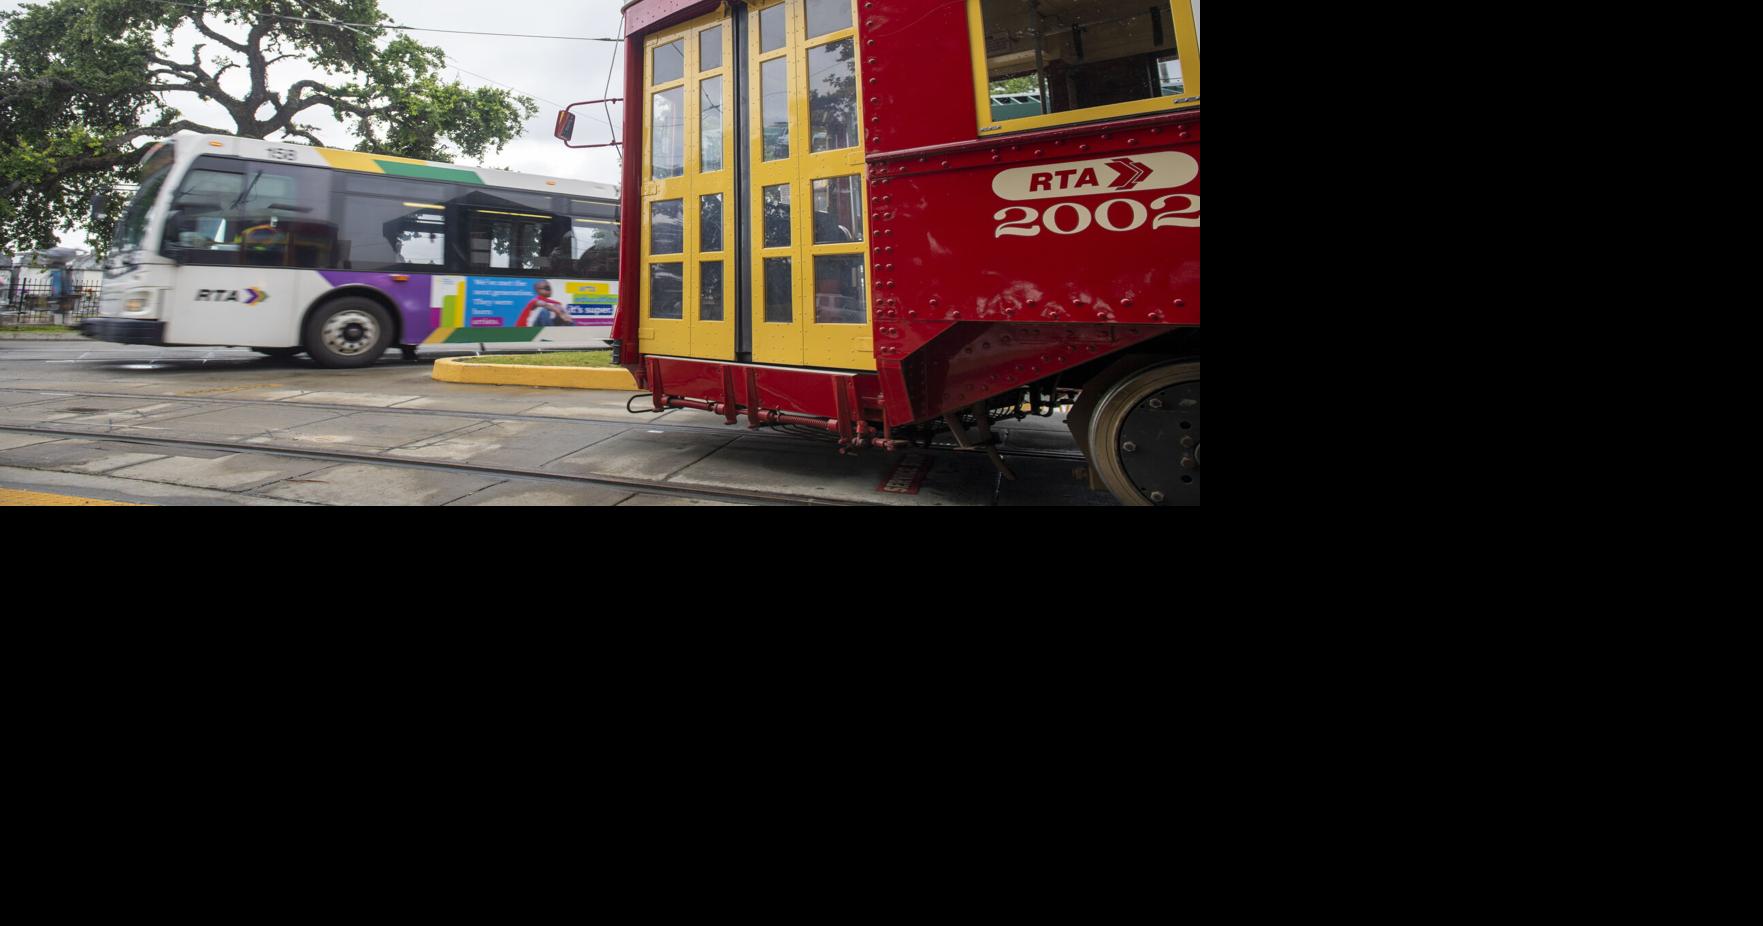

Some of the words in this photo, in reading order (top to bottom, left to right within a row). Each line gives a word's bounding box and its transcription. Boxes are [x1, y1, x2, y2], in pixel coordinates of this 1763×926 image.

[1029, 167, 1100, 192] RTA
[993, 193, 1200, 238] 2002
[195, 289, 240, 301] RTA
